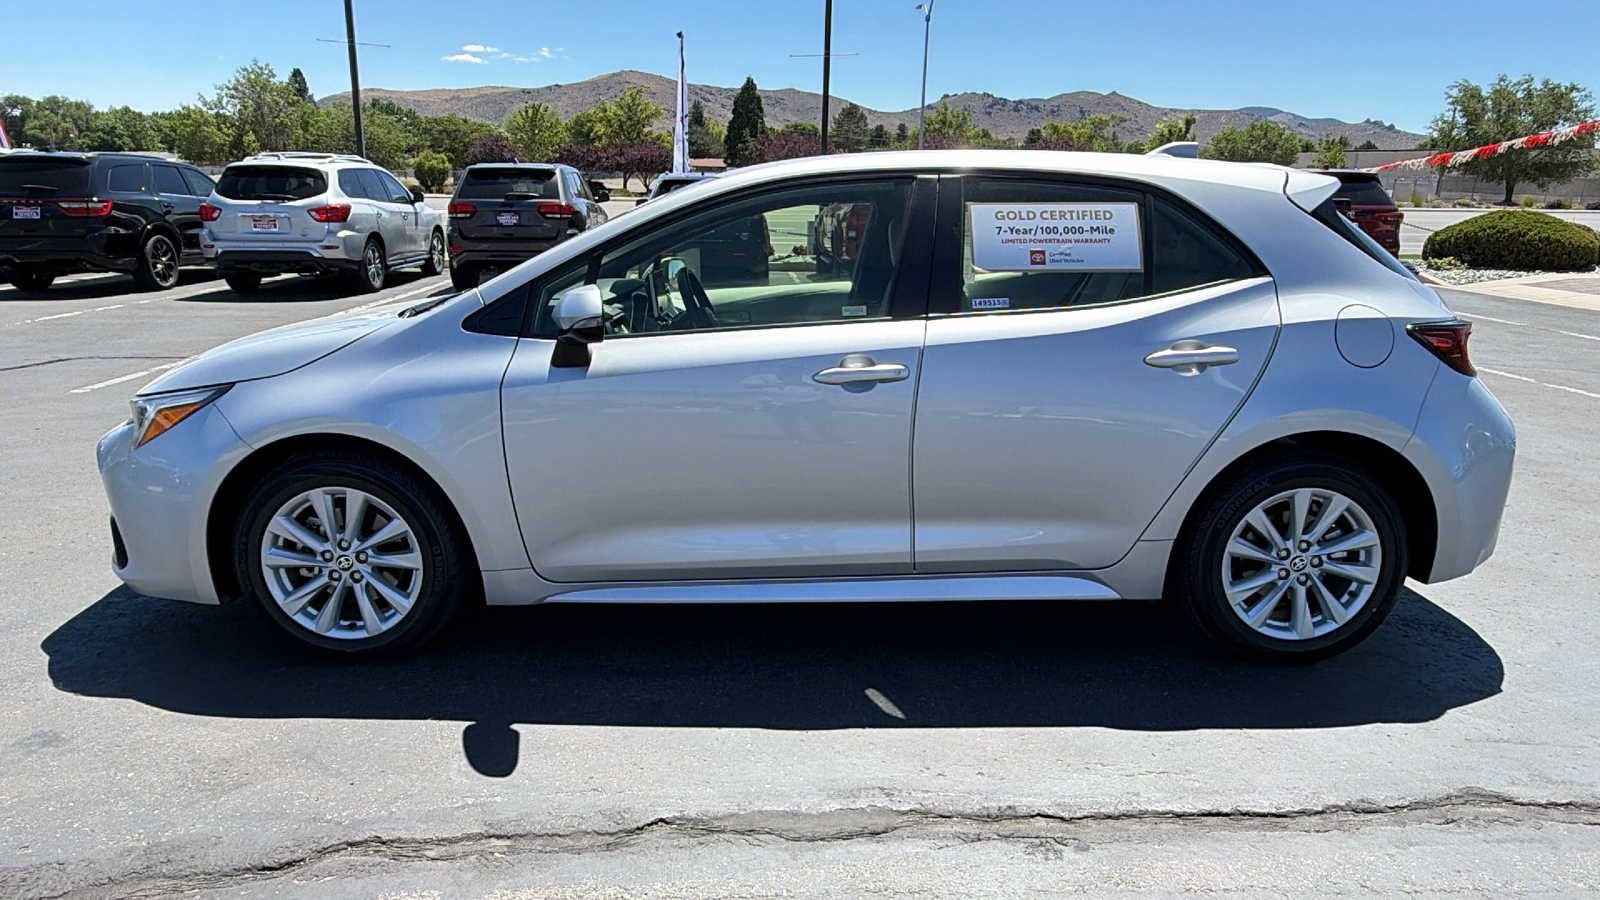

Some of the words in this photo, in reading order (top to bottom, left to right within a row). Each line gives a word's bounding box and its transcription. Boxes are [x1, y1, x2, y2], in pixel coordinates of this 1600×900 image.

[994, 210, 1037, 221] GOLD
[1040, 210, 1113, 221] CERTIFIED
[995, 225, 1115, 236] 7-Year/100,000-Mile
[1216, 478, 1271, 529] OMNIMAX
